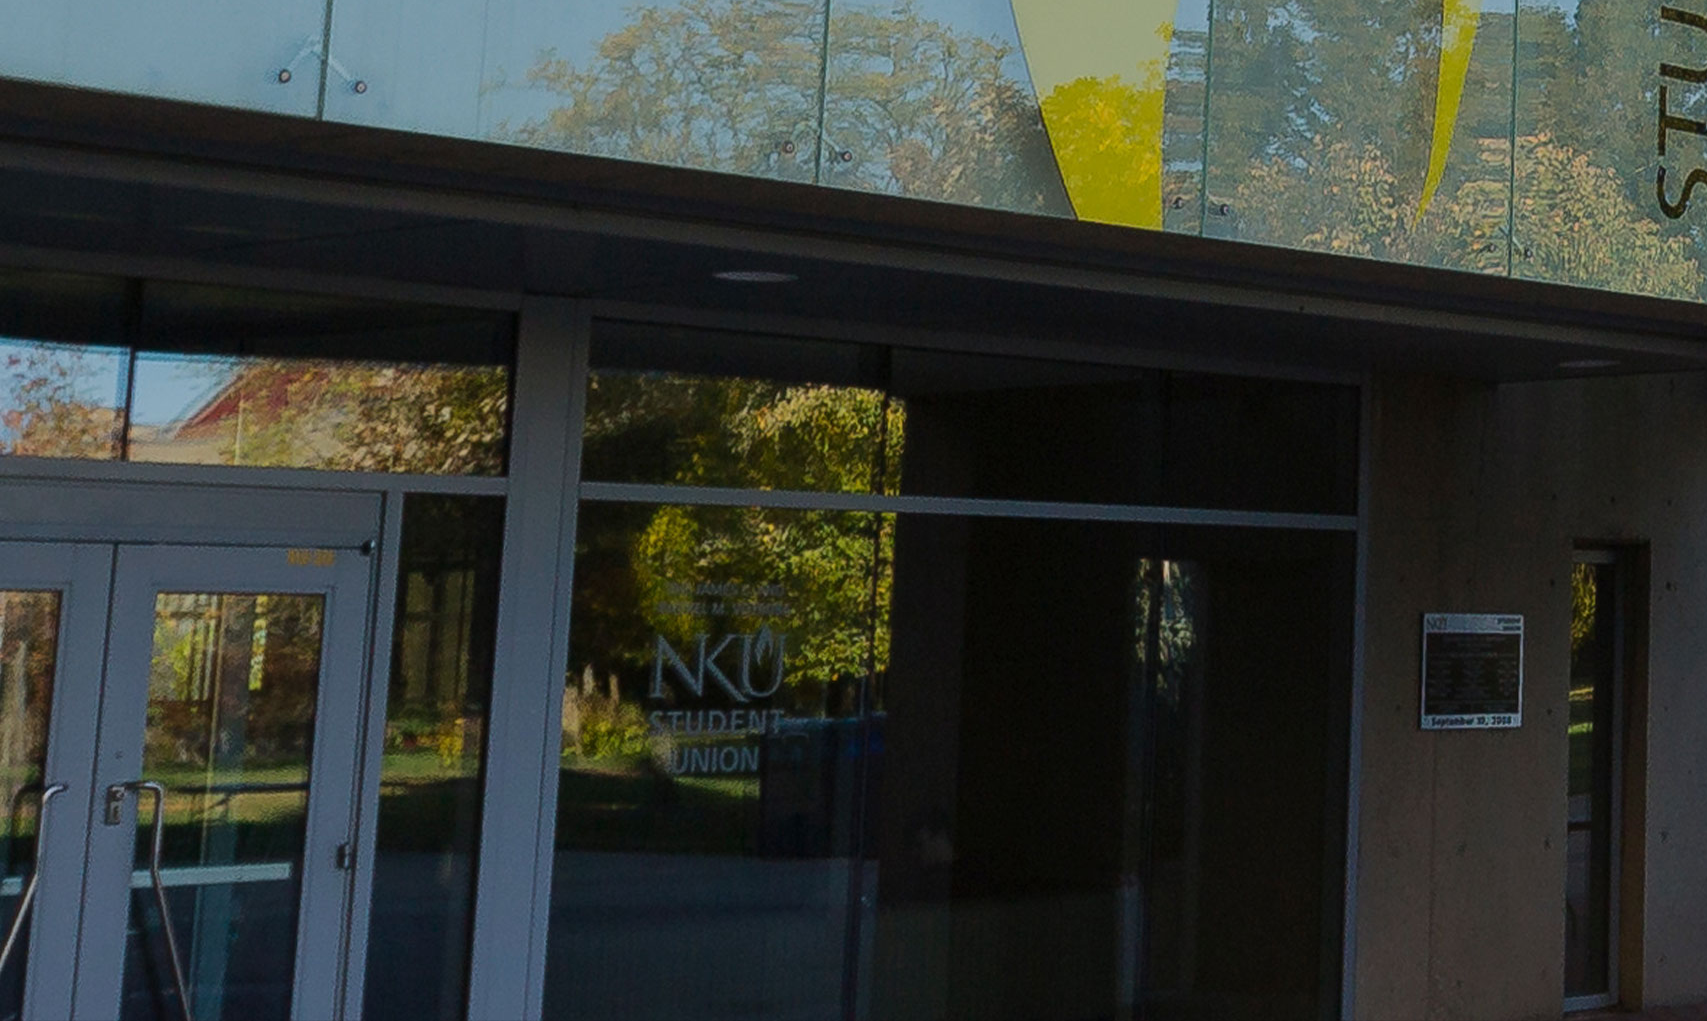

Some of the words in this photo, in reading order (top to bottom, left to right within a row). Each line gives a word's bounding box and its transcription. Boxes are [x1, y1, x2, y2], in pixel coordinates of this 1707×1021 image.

[649, 633, 787, 702] NKU
[649, 709, 785, 735] STUDENT
[670, 746, 760, 774] UNION
